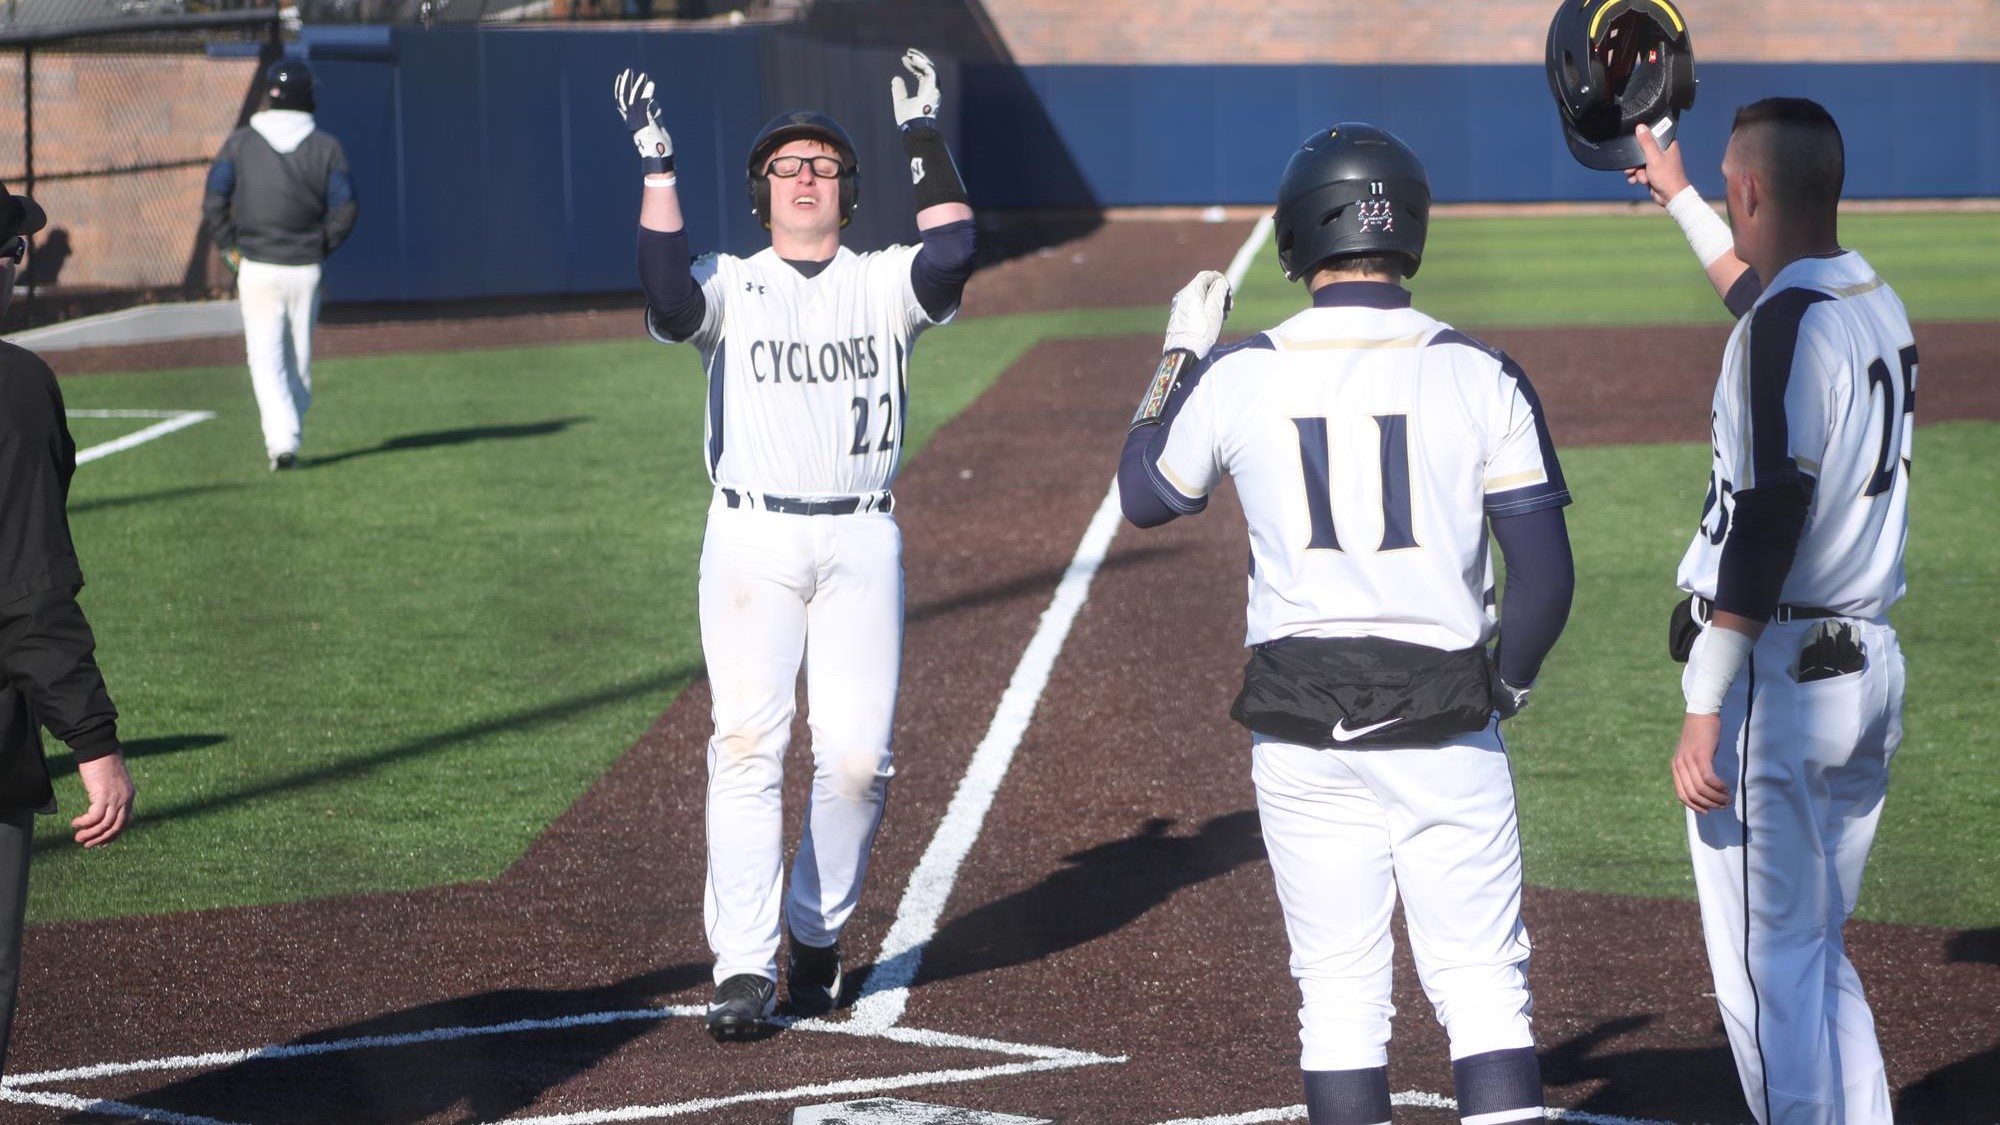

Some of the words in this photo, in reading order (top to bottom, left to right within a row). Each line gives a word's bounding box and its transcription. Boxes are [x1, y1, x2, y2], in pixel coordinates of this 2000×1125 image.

[1370, 182, 1383, 195] 11
[750, 335, 879, 384] CYCLONES
[849, 392, 895, 455] 22
[1289, 412, 1422, 554] 11
